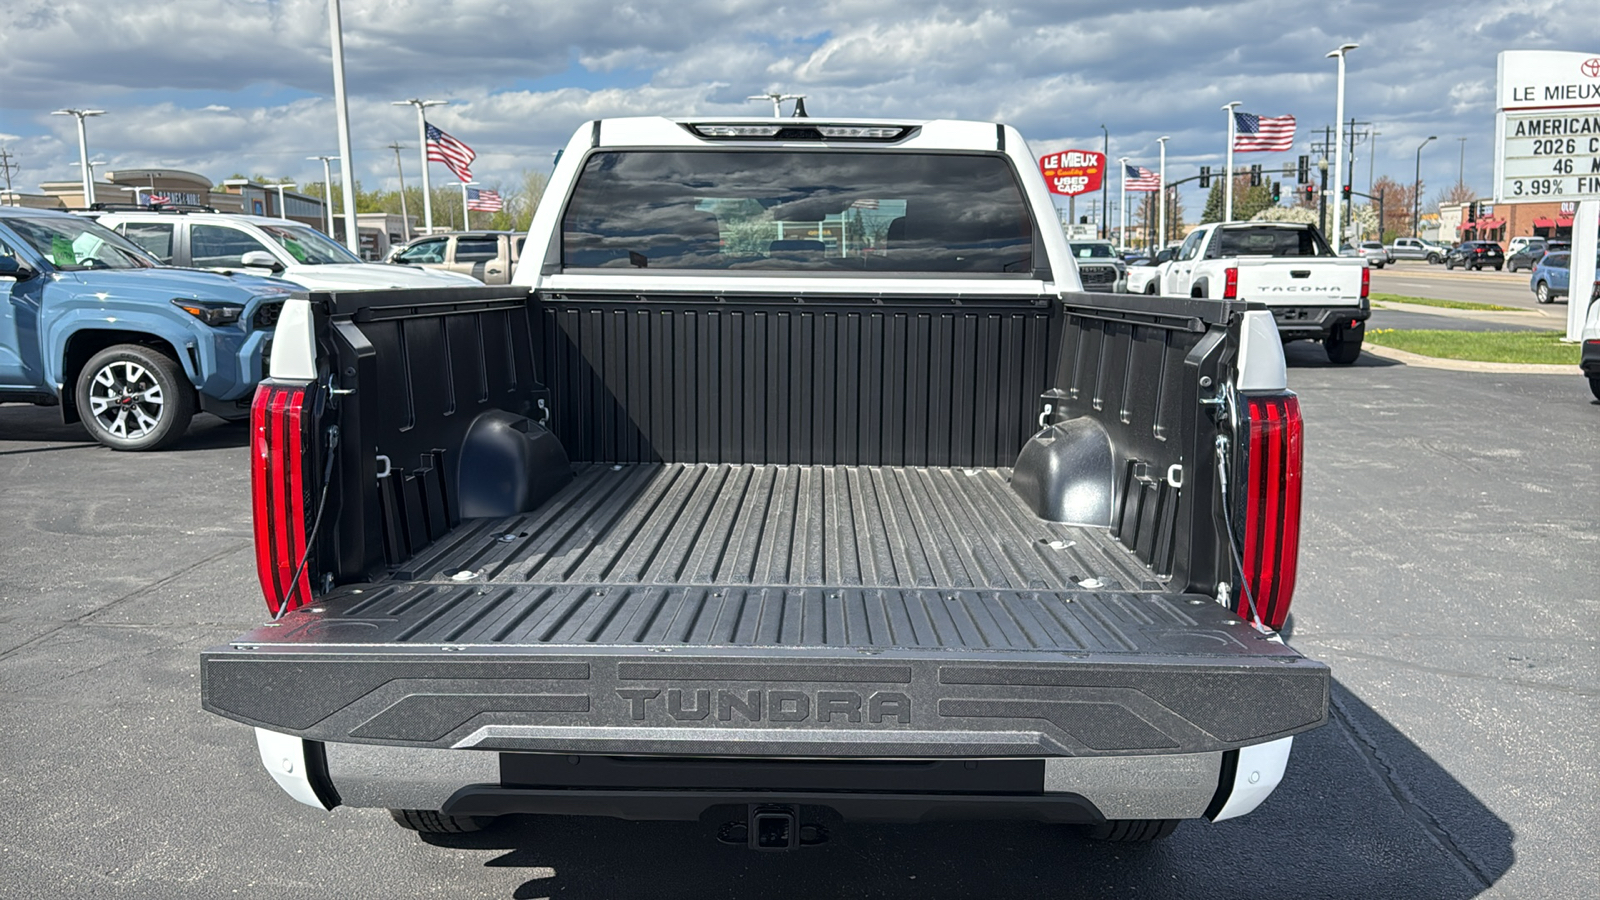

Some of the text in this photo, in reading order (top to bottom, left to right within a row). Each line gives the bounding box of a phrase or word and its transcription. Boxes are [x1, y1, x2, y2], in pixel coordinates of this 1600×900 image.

[1513, 84, 1600, 101] LE MIEUX
[1515, 117, 1600, 136] AMERICAN
[1533, 138, 1576, 155] 2026
[1044, 152, 1098, 169] LE MIEUX
[1553, 158, 1573, 174] 46
[1054, 176, 1089, 185] USED
[1057, 184, 1085, 193] CARS
[1513, 179, 1563, 196] 3.99%
[1561, 202, 1575, 212] OLD
[615, 688, 911, 723] TUNDRA
